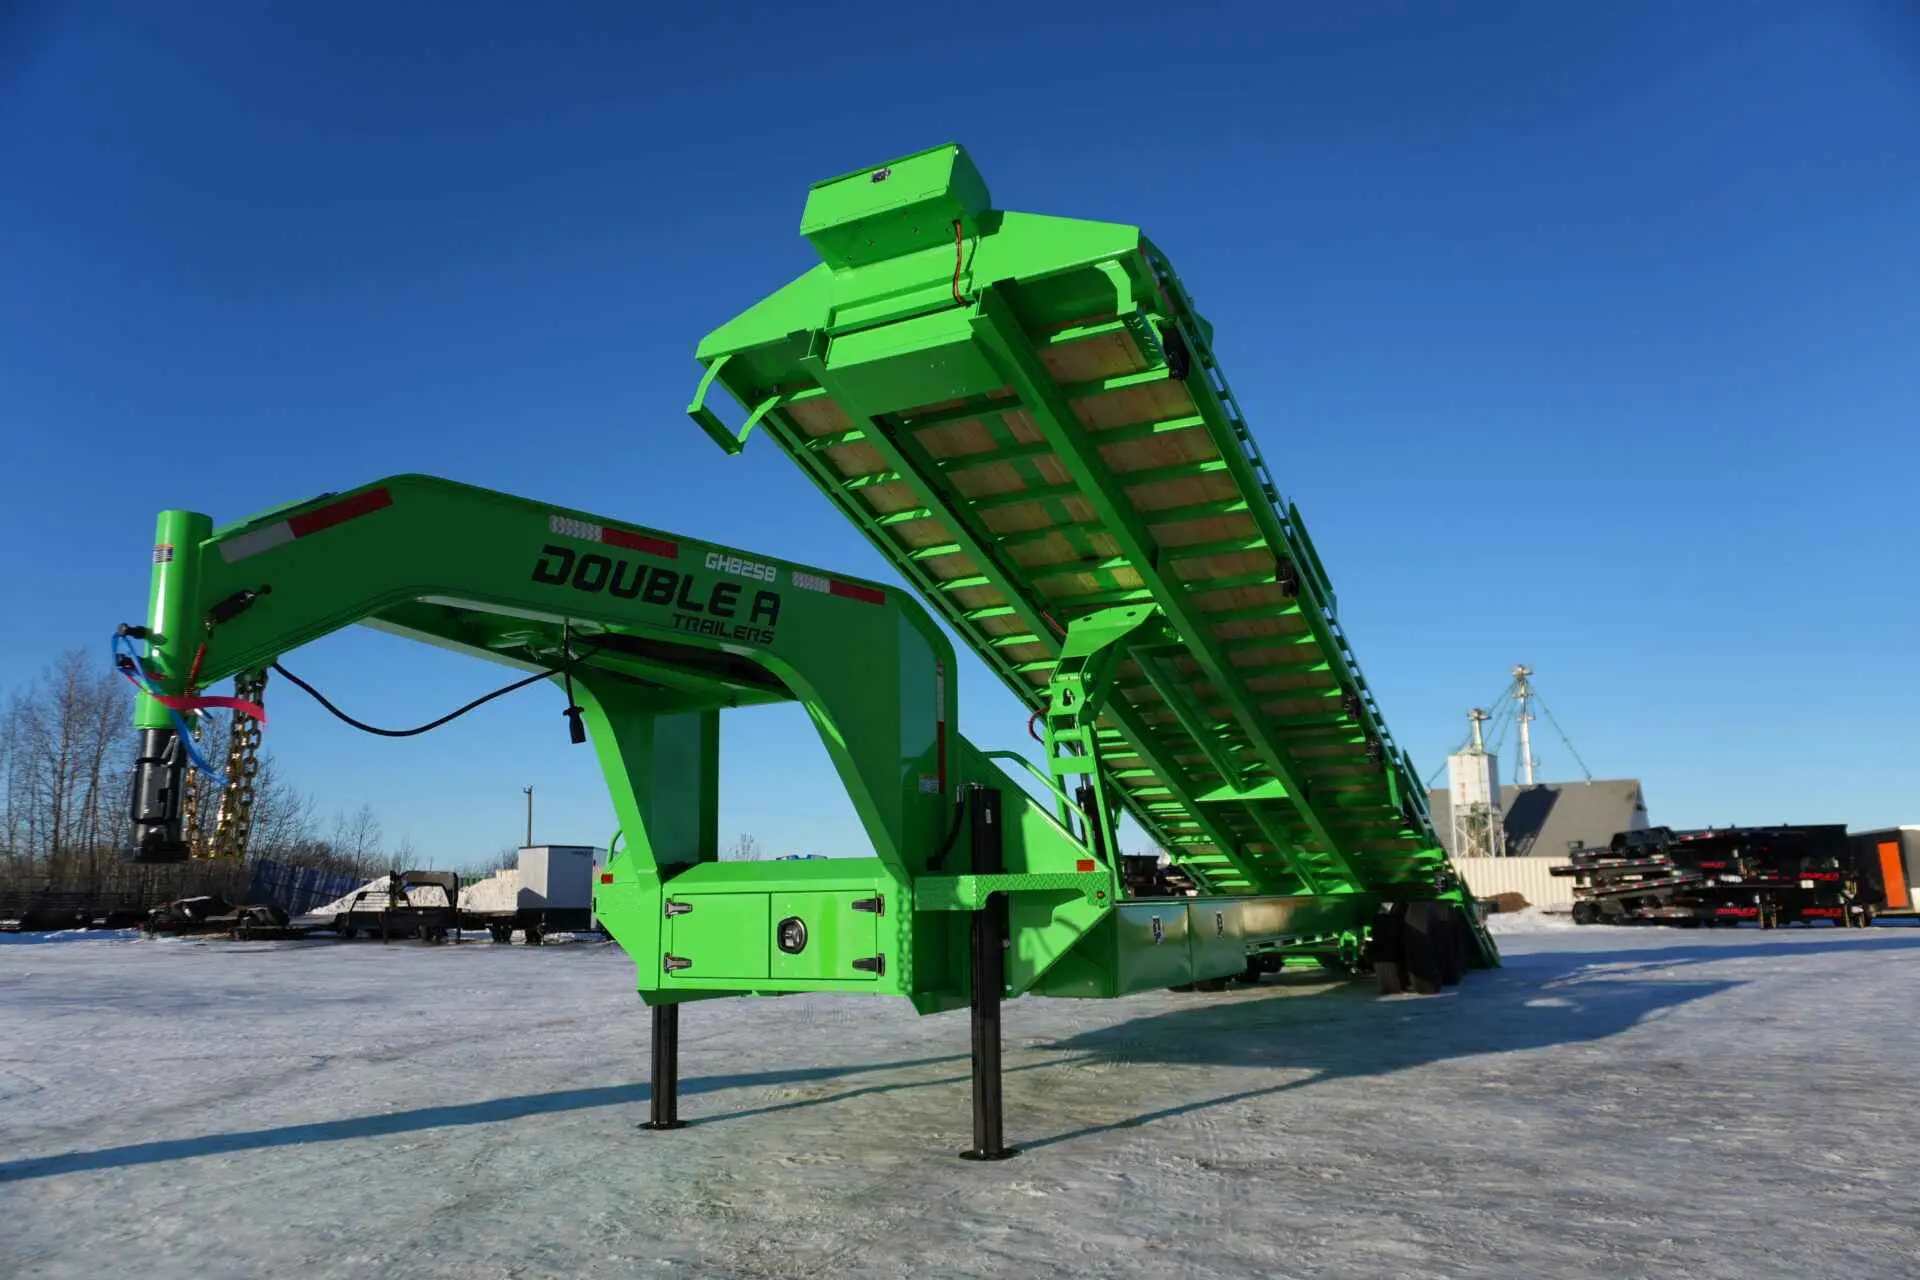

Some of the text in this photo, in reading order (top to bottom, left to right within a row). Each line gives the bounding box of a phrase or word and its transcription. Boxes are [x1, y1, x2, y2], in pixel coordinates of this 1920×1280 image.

[532, 544, 780, 627] DOUBLE A
[673, 612, 775, 645] TRAILERS
